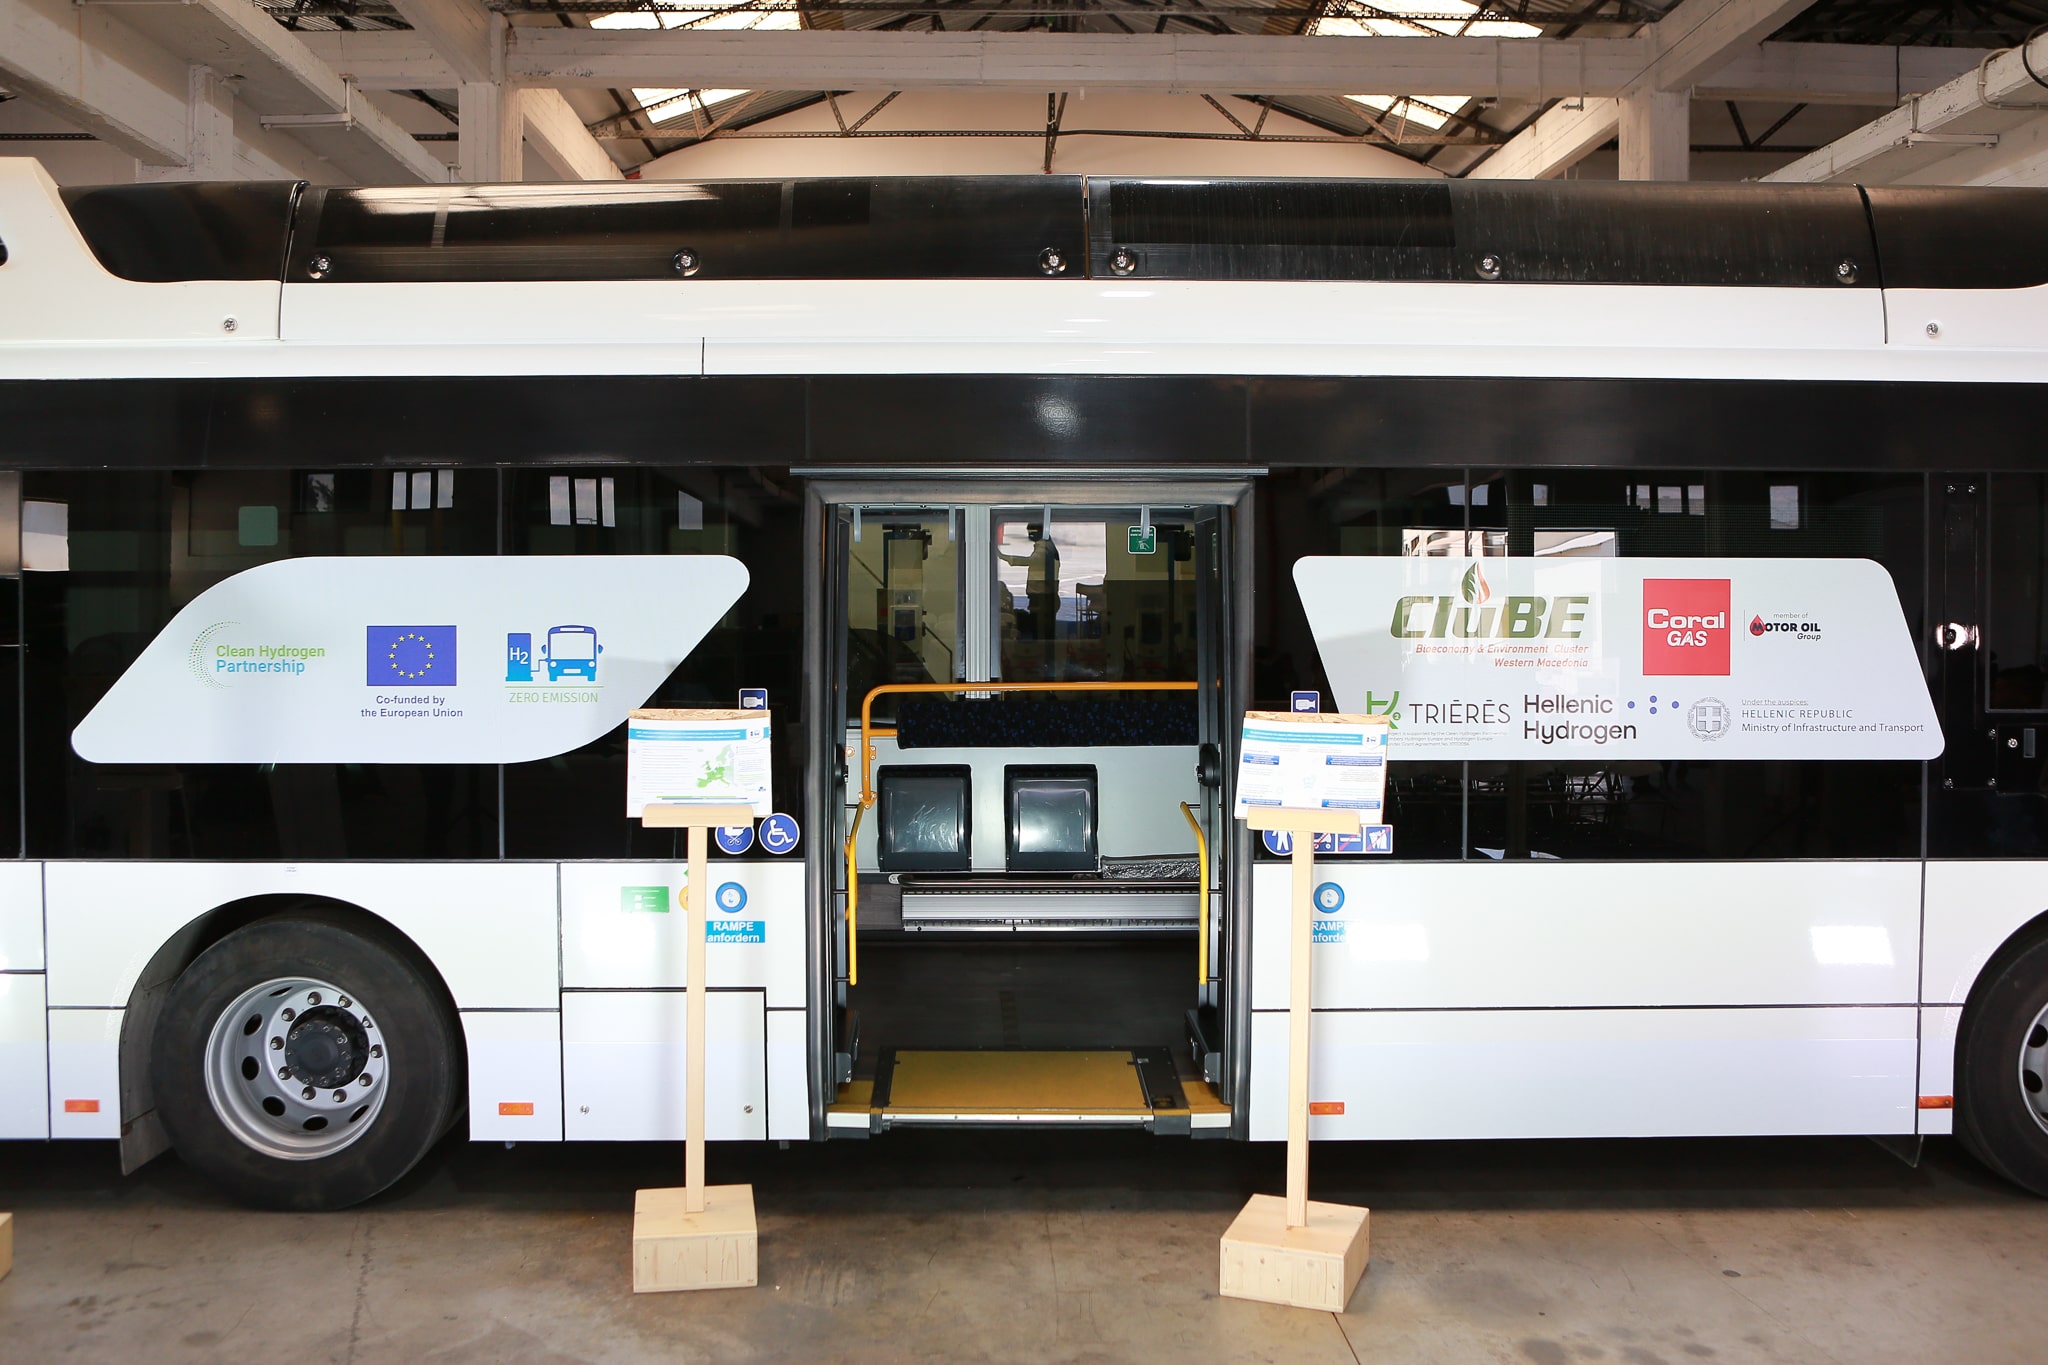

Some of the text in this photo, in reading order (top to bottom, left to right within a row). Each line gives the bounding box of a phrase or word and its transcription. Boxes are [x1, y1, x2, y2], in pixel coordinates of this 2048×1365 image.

[1647, 608, 1726, 629] Coral
[1752, 622, 1821, 632] MOTOR OIL
[1667, 630, 1708, 647] GAS
[1797, 633, 1821, 641] Group
[216, 645, 325, 660] Clean Hydrogen
[1415, 643, 1589, 655] Bioeconomy & Environment Cluster
[1494, 657, 1588, 667] Western Macedonia
[216, 660, 305, 676] Partnership
[376, 695, 446, 706] Co-funded by
[509, 692, 599, 703] ZERO EMISSION
[1524, 694, 1614, 714] Hellenic
[360, 708, 463, 719] the European Union
[1409, 699, 1511, 724] TRIĒRĒS
[1742, 709, 1853, 719] HELLENIC REPUBLIC
[1524, 720, 1637, 745] Hydrogen
[1741, 723, 1924, 734] Ministry of Infrastructure and Transport
[713, 921, 754, 932] RAMPE
[1312, 921, 1346, 931] RAMP
[707, 933, 760, 943] anfordern
